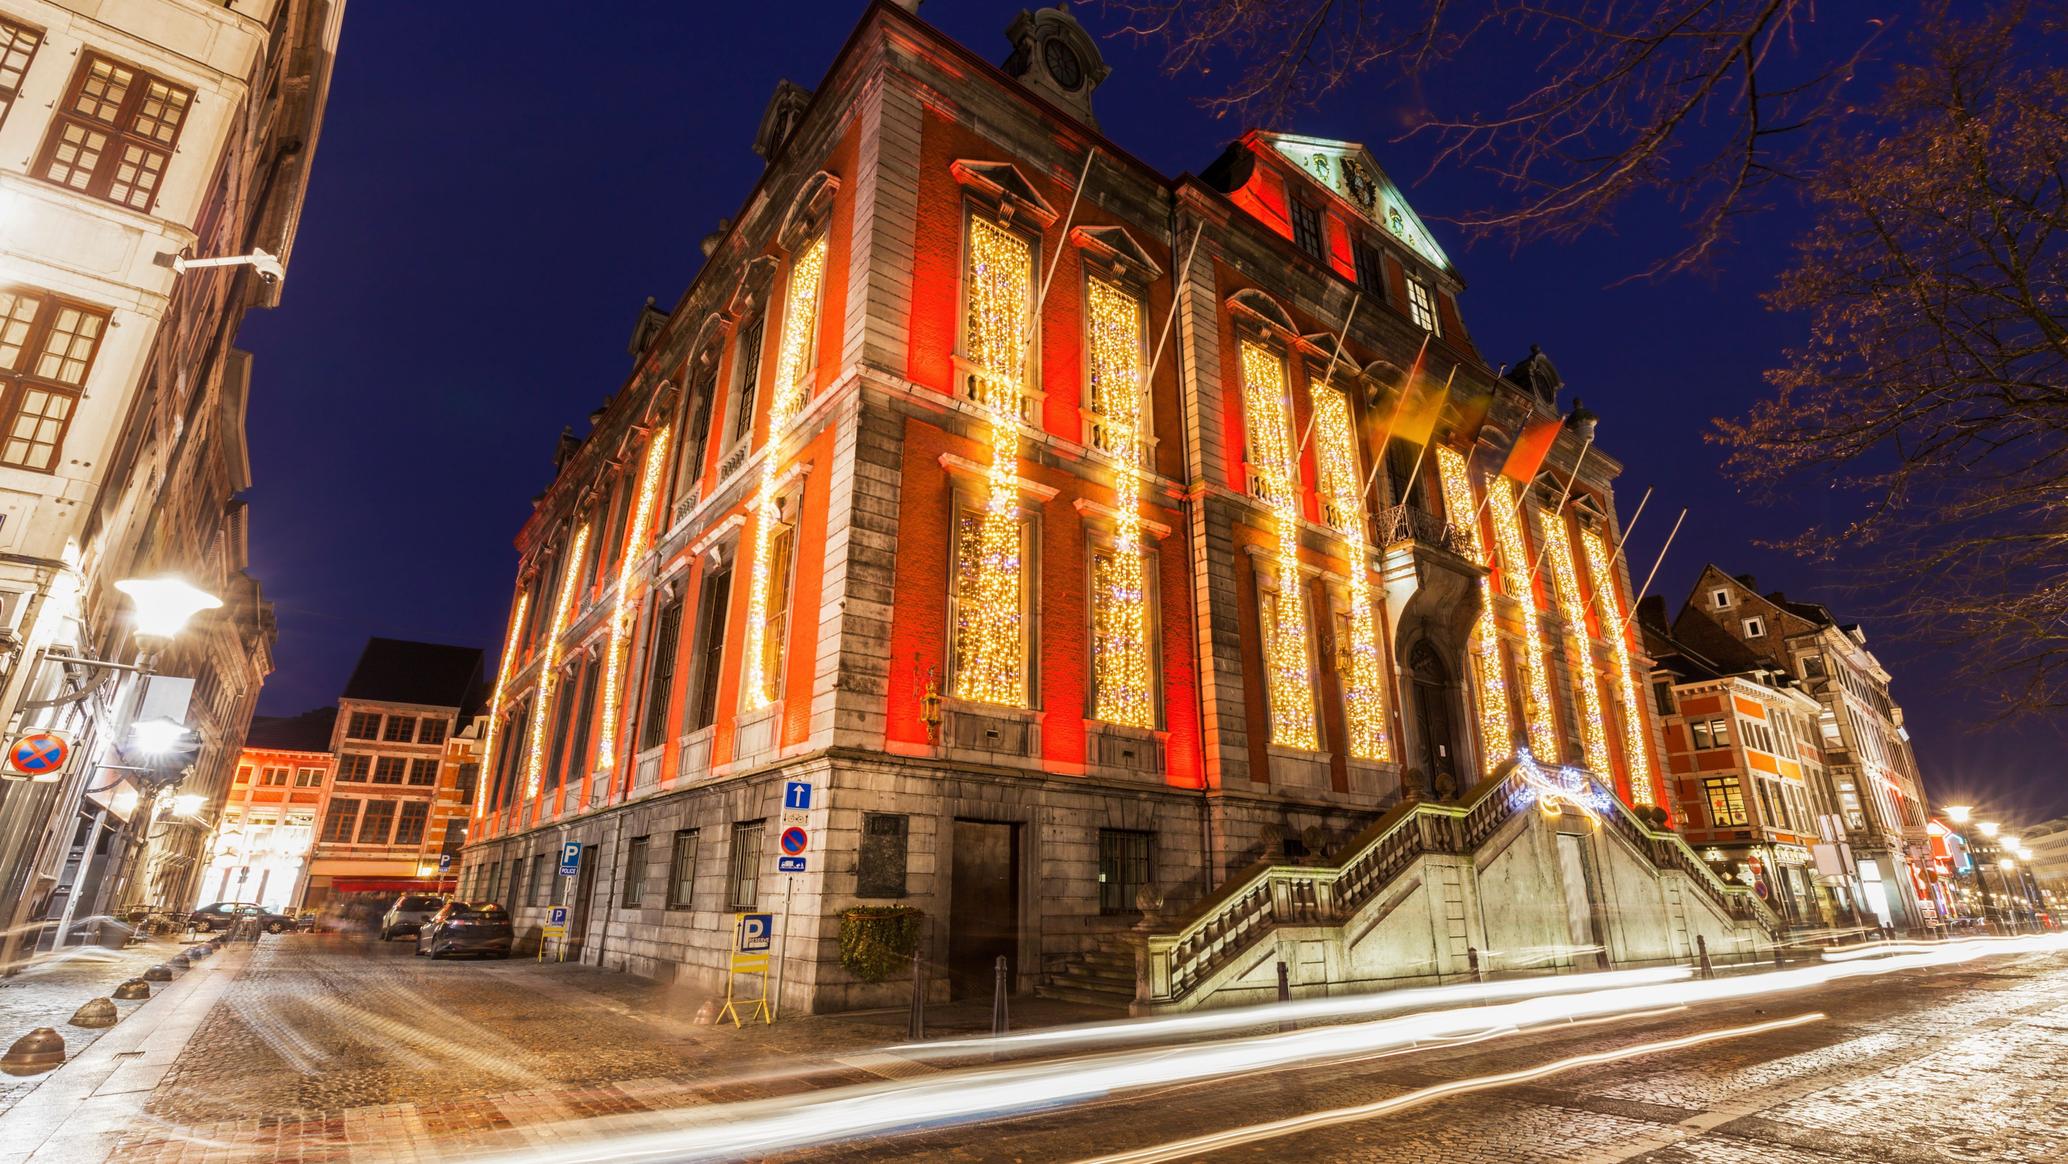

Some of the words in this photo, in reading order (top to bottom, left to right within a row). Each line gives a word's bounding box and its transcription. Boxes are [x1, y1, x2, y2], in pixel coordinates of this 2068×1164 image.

[440, 854, 450, 866] P
[564, 845, 578, 863] P
[555, 910, 563, 921] P
[743, 919, 763, 948] P
